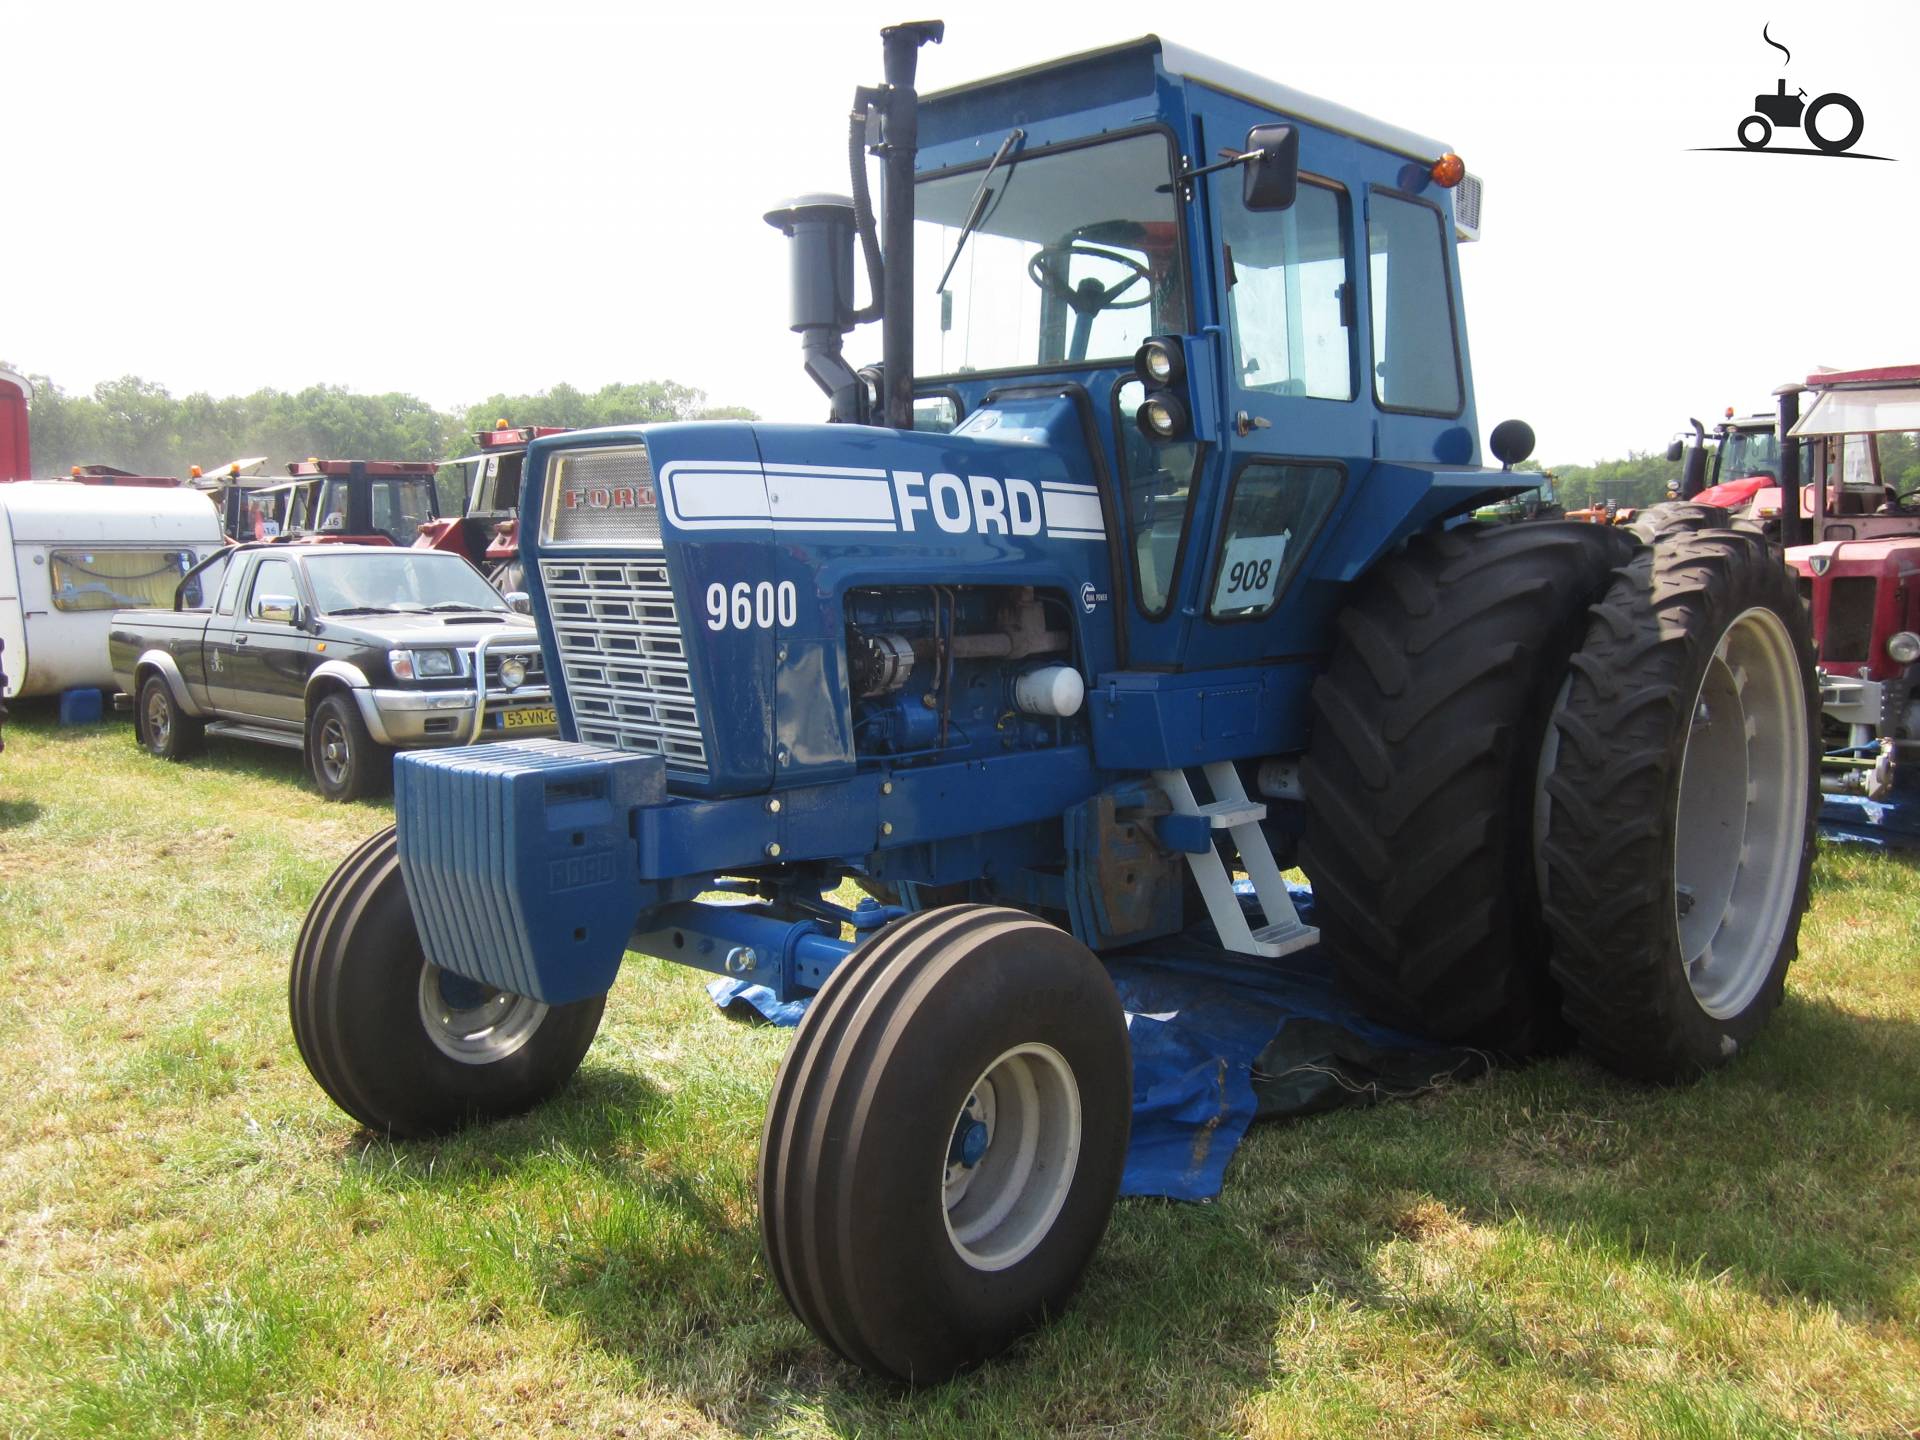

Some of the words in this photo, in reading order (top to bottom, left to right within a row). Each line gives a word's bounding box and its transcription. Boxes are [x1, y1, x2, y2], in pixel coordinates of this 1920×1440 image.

[565, 486, 657, 509] FORD
[892, 470, 1042, 536] FORD
[1227, 558, 1272, 594] 908
[706, 580, 797, 631] 9600
